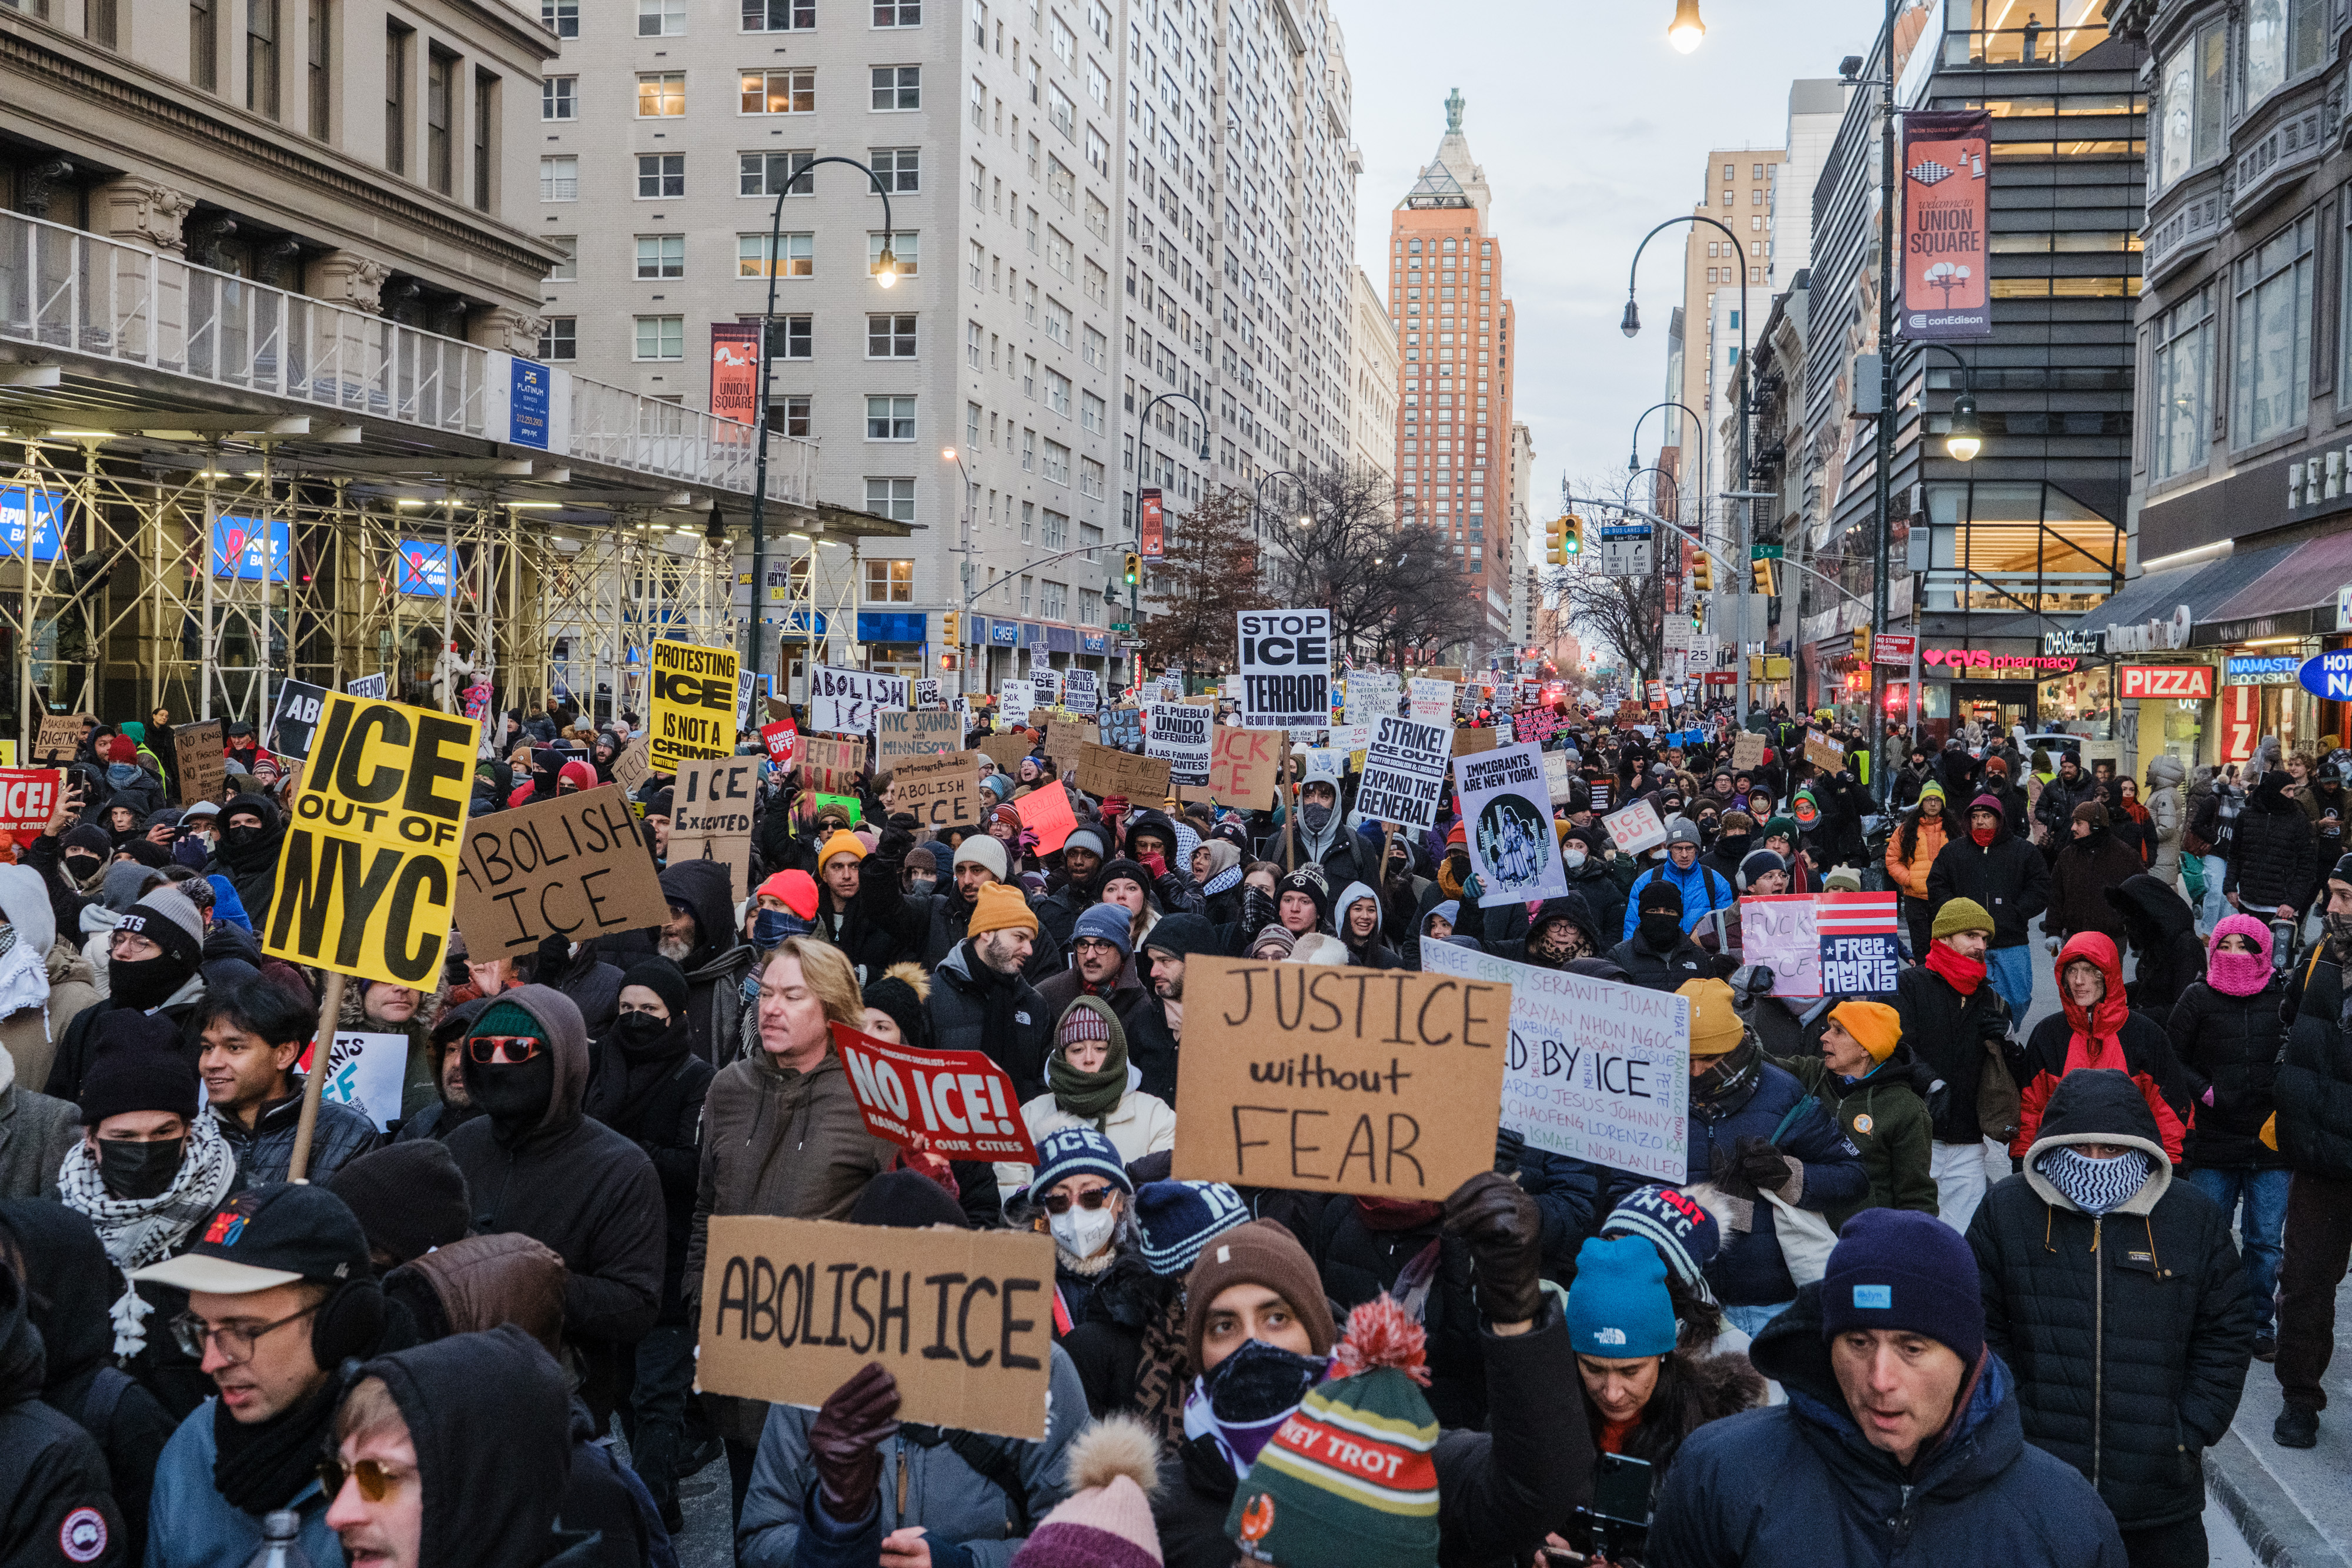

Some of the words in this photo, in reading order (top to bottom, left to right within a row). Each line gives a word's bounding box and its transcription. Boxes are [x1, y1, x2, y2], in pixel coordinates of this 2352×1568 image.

[1919, 209, 1973, 232] UNION
[1911, 231, 1980, 257] SQUARE
[1929, 315, 1983, 325] conEdison
[517, 383, 543, 396] PLATINUM
[523, 395, 537, 403] SERVICES
[720, 383, 749, 395] UNION
[715, 396, 752, 410] SQUARE
[767, 572, 787, 587] HEKTIC
[994, 626, 1013, 641] CHASE
[1242, 616, 1326, 635] STOP
[655, 643, 734, 678] PROTESTING
[1243, 637, 1327, 665] ICE
[1691, 651, 1708, 660] 25
[1945, 649, 1991, 667] CVS
[1993, 654, 2077, 671] pharmacy
[1068, 670, 1094, 682] JUSTICE
[1349, 672, 1381, 682] DEMOCRATS
[2230, 657, 2300, 673] NAMASTE
[654, 670, 732, 711] ICE
[812, 670, 904, 707] ABOLISH
[916, 680, 937, 690] STOP
[1067, 680, 1078, 691] FOR
[1079, 682, 1094, 692] ALEX
[1244, 674, 1328, 713] TERROR
[2126, 670, 2207, 694] PIZZA
[918, 690, 939, 704] ICE
[44, 719, 61, 728] MAKE
[61, 720, 66, 728] A
[882, 713, 908, 732] NYC
[915, 713, 957, 732] STANDS
[1099, 708, 1139, 727] OUT
[1151, 705, 1167, 716] ¡EL
[1170, 708, 1210, 718] PUEBLO
[1245, 716, 1255, 726] ICE
[1255, 716, 1266, 726] OUT
[1267, 716, 1274, 726] OF
[1275, 716, 1287, 726] OUR
[1287, 716, 1327, 726] COMMUNITIES
[663, 712, 676, 737] IS
[678, 716, 708, 744] NOT
[711, 721, 720, 746] A
[767, 729, 794, 743] HANDS
[1053, 721, 1075, 731] POWER
[1100, 726, 1142, 745] ICE
[1152, 731, 1206, 744] DEFENDERÁ
[1156, 716, 1204, 735] UNIDO
[1378, 717, 1446, 754] STRIKE!
[39, 731, 68, 745] RIGHT
[180, 735, 195, 750] NO
[201, 730, 222, 743] KINGS
[883, 741, 956, 755] MINNESOTA
[181, 754, 192, 764] NO
[196, 750, 223, 760] FASCISM
[309, 699, 472, 821] ICE
[794, 737, 863, 768] DEFUND
[1090, 747, 1132, 774] ICE
[1172, 751, 1208, 761] FAMILIAS
[1370, 742, 1399, 756] ICE
[1401, 749, 1446, 766] OUT!
[1369, 754, 1382, 764] PARTY
[1391, 758, 1412, 770] SOCIALISM
[1418, 765, 1442, 776] LIBERATION
[1466, 754, 1530, 778] IMMIGRANTS
[687, 767, 748, 802] ICE
[898, 780, 964, 800] ABOLISH
[1362, 768, 1412, 795] EXPAND
[1414, 778, 1439, 801] THE
[1464, 775, 1482, 793] ARE
[1483, 771, 1506, 788] NEW
[1507, 766, 1539, 784] YORK!
[0, 781, 51, 818] ICE!
[1024, 791, 1067, 820] ABOLITION
[1358, 788, 1431, 827] GENERAL
[298, 795, 389, 833] OUT
[399, 817, 457, 847] OF
[676, 807, 749, 832] EXECUTED
[908, 797, 968, 828] ICE
[1610, 807, 1646, 831] ICE
[0, 822, 18, 830] OUR
[21, 822, 47, 830] CITIES
[1616, 818, 1655, 843] OUT
[457, 798, 642, 892] ABOLISH
[269, 828, 447, 981] NYC
[493, 868, 627, 947] ICE
[1078, 925, 1104, 934] Benedictine
[1750, 912, 1809, 936] FUCK
[1424, 942, 1468, 971] RENEE
[1477, 959, 1526, 991] GENRY
[1532, 972, 1615, 1004] SERAWIT
[1619, 991, 1668, 1018] JUAN
[1224, 967, 1495, 1048] JUSTICE
[1580, 1014, 1625, 1038] NHON
[1632, 1025, 1675, 1049] NGOC
[1574, 1031, 1623, 1054] HASAN
[1628, 1045, 1677, 1067] JOSUE
[1250, 1054, 1412, 1095] without
[1542, 1040, 1581, 1081] BY
[1596, 1052, 1651, 1098] ICE
[845, 1047, 909, 1121] NO
[912, 1069, 1014, 1135] ICE!
[1552, 1089, 1604, 1112] JESUS
[1609, 1102, 1672, 1128] JOHNNY
[868, 1112, 909, 1138] HANDS
[935, 1139, 971, 1151] OUR
[975, 1139, 1023, 1152] CITIES
[1508, 1099, 1584, 1132] CHAOFENG
[1588, 1119, 1663, 1149] LORENZO
[1666, 1138, 1686, 1156] KAI
[1045, 1130, 1108, 1161] ICE
[1232, 1105, 1425, 1186] FEAR
[1530, 1126, 1583, 1152] ISMAEL
[1588, 1144, 1648, 1171] NORLAN
[1654, 1157, 1685, 1177] LEO
[1635, 1194, 1692, 1237] NYC
[1660, 1190, 1705, 1225] OUT
[716, 1256, 911, 1355] ABOLISH
[921, 1273, 1043, 1370] ICE
[1328, 1436, 1404, 1478] TROT
